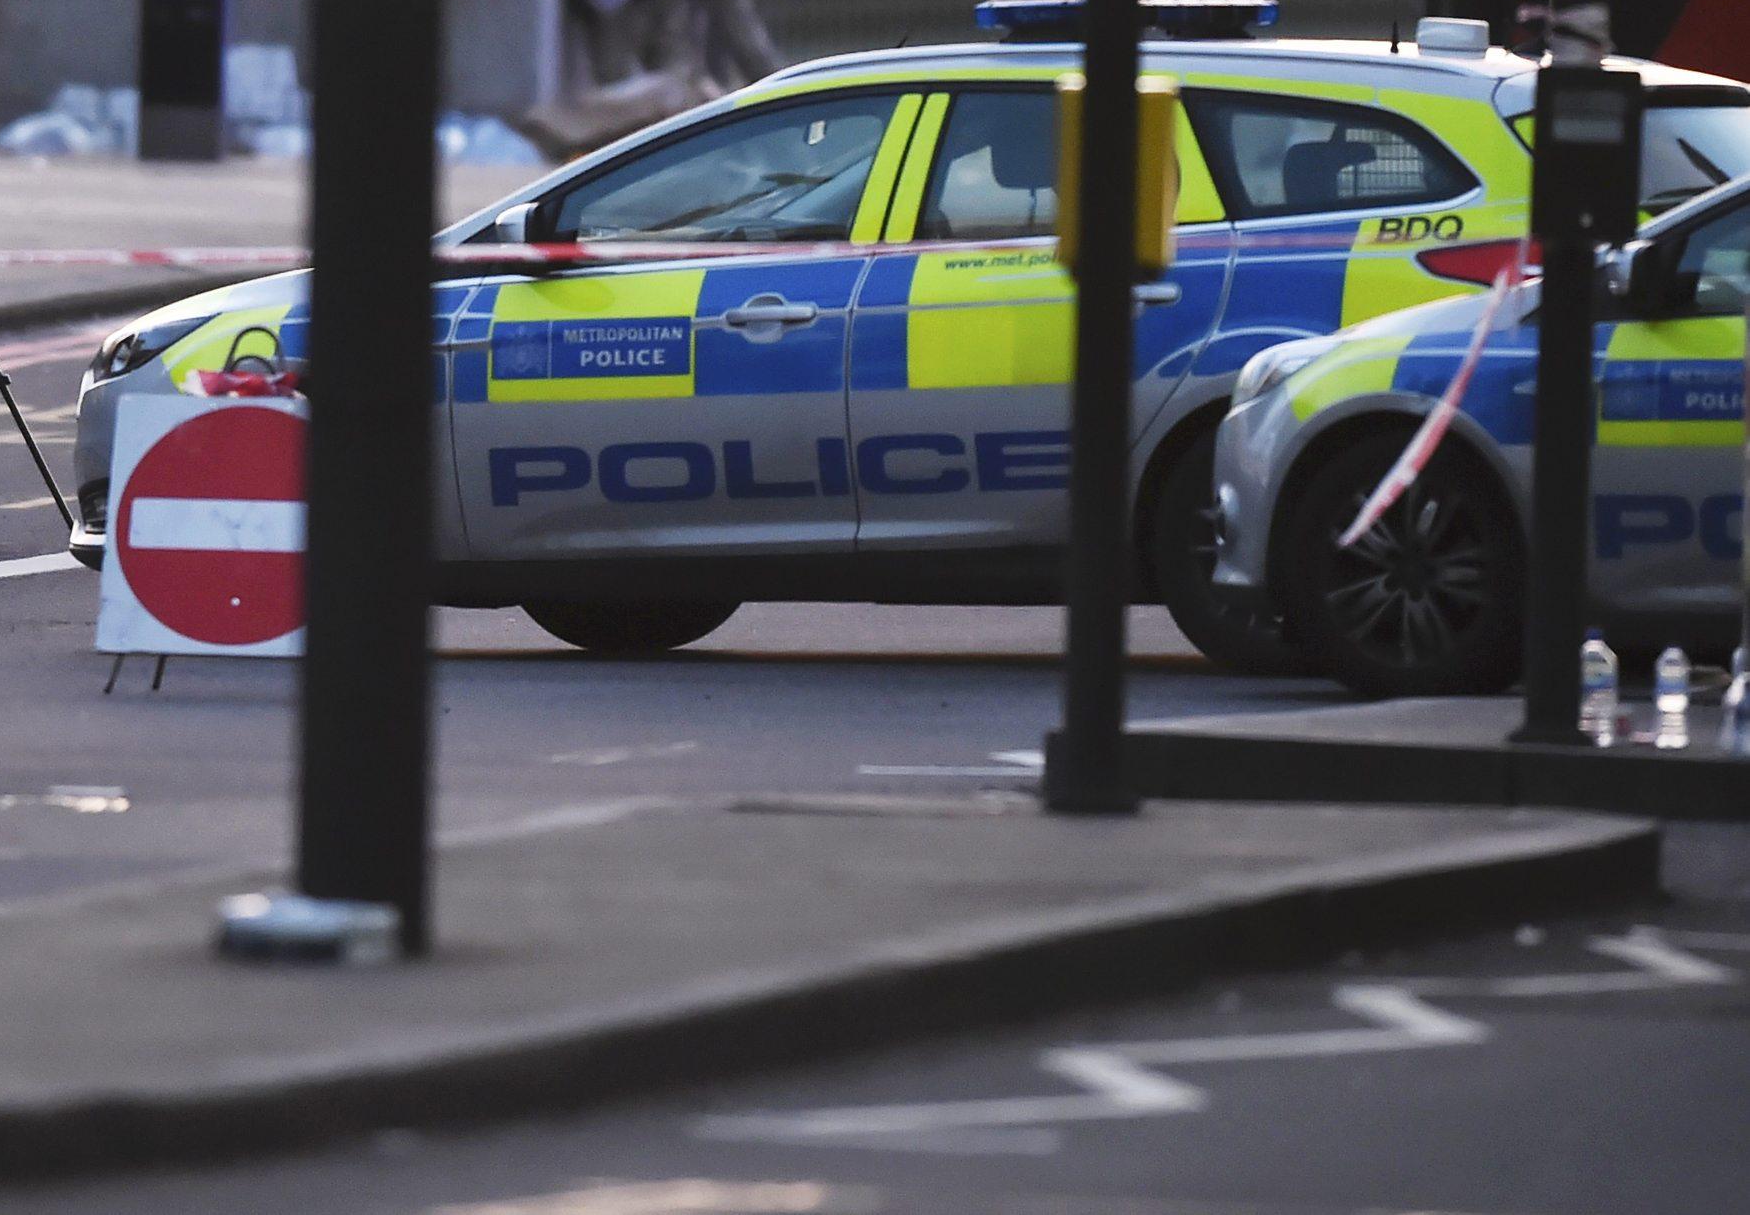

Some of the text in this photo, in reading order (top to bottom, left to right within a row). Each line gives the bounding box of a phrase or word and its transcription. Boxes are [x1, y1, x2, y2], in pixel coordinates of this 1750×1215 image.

[563, 326, 683, 343] METROPOLITAN
[580, 347, 666, 367] POLICE
[488, 430, 1072, 507] POLICE
